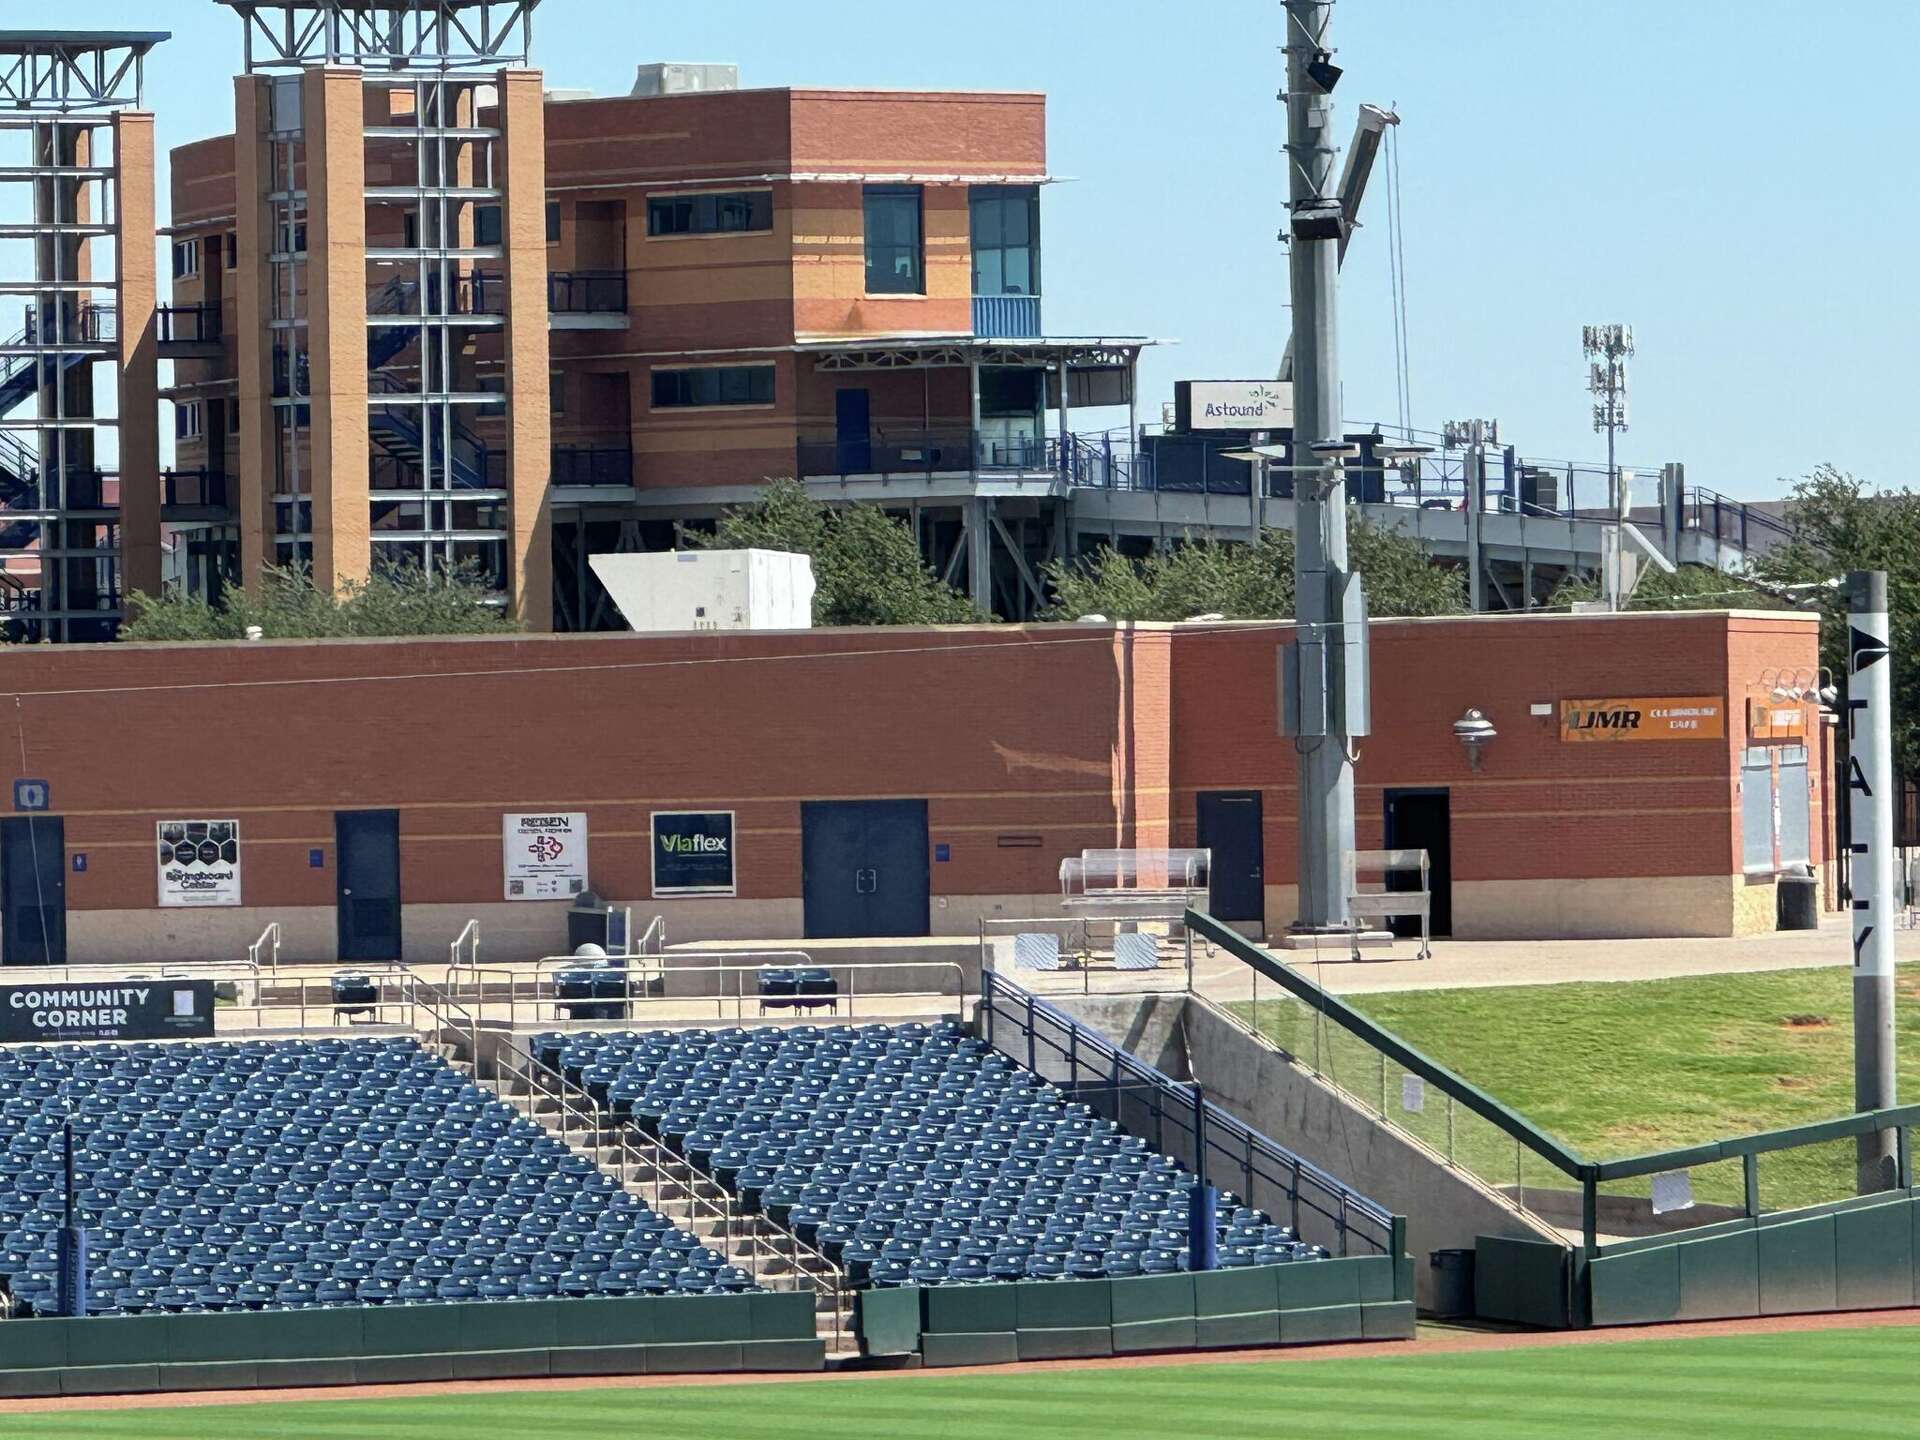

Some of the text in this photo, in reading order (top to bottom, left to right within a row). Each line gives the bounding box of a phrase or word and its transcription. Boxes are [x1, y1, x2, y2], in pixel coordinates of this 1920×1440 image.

[1205, 402, 1263, 417] Astound
[660, 833, 727, 852] Viaflex
[9, 988, 149, 1008] COMMUNITY
[32, 1009, 127, 1027] CORNER
